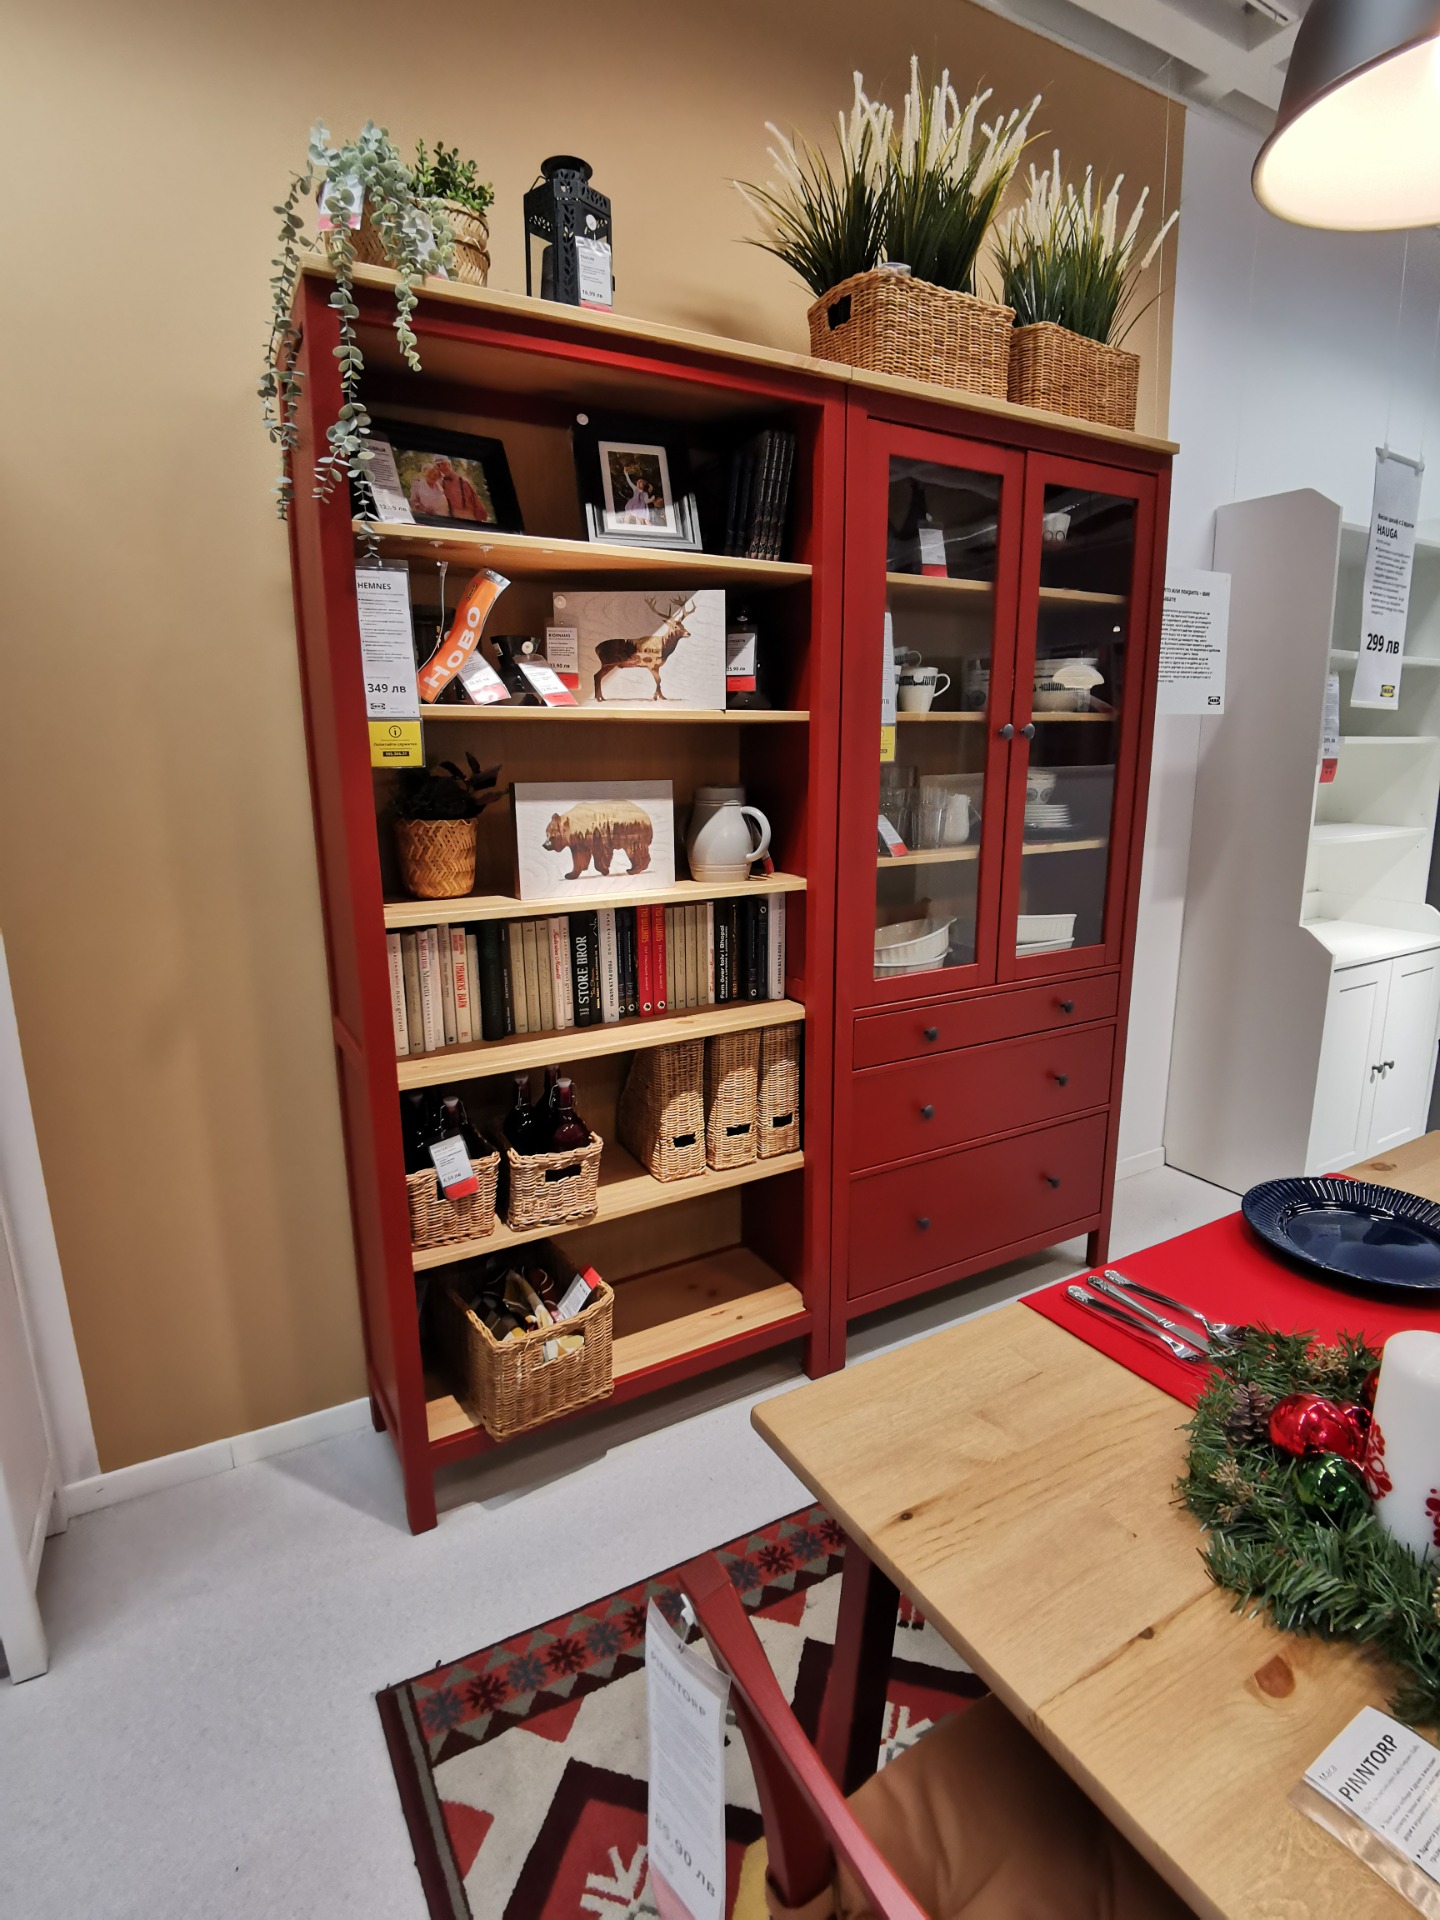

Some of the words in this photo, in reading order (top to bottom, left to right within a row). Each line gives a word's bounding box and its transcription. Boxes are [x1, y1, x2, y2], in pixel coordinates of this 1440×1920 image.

[1377, 523, 1398, 540] HAUGA
[357, 582, 392, 590] HEMNES
[423, 606, 481, 688] НОВО
[1366, 632, 1385, 653] 299
[1386, 640, 1400, 654] лв
[367, 683, 388, 693] 349
[418, 938, 430, 970] Katarina
[576, 935, 588, 964] BROR
[577, 967, 590, 1004] STORE
[457, 993, 468, 1009] BARN
[650, 1650, 706, 1716] PINNTORP
[1318, 1764, 1338, 1781] Маса
[1338, 1733, 1398, 1802] PINNTORP
[696, 1869, 715, 1897] лв
